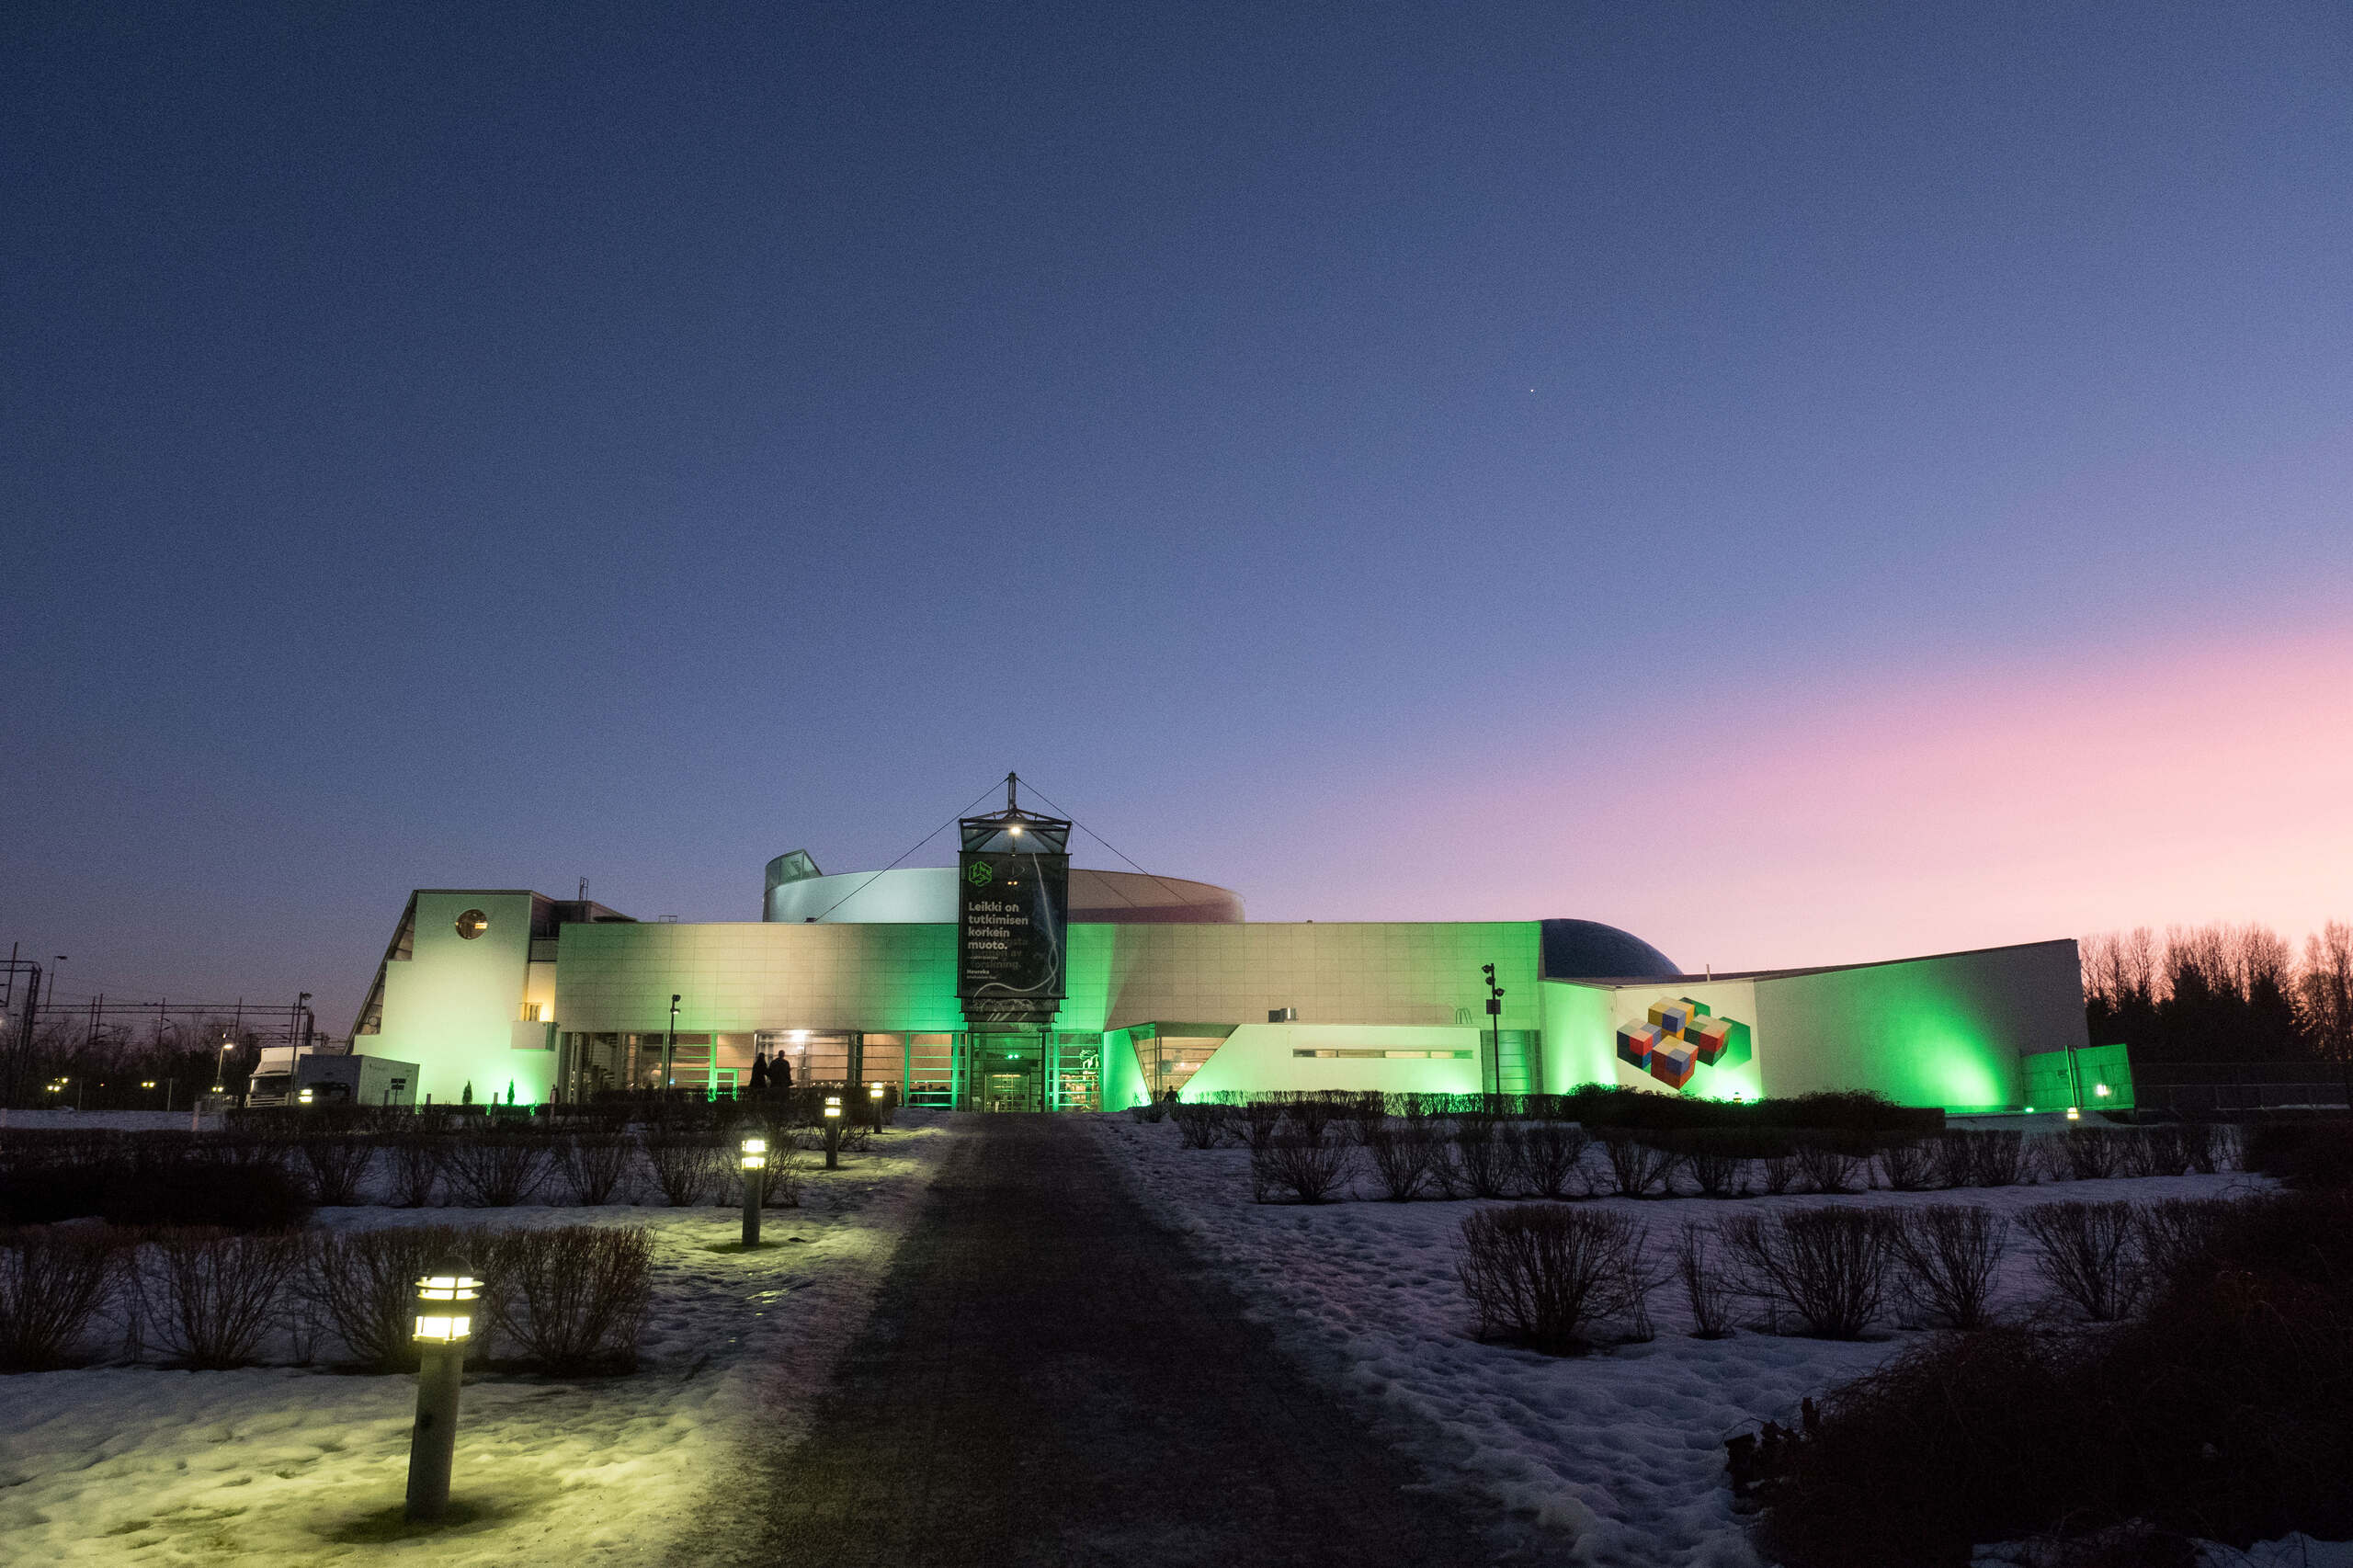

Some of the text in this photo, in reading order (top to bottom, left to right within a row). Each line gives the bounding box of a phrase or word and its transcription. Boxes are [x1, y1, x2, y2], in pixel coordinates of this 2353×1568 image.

[968, 902, 1002, 912] Leikki
[968, 914, 1029, 925] tutkimisen
[968, 926, 1010, 937] korkein
[968, 940, 1008, 949] muoto.
